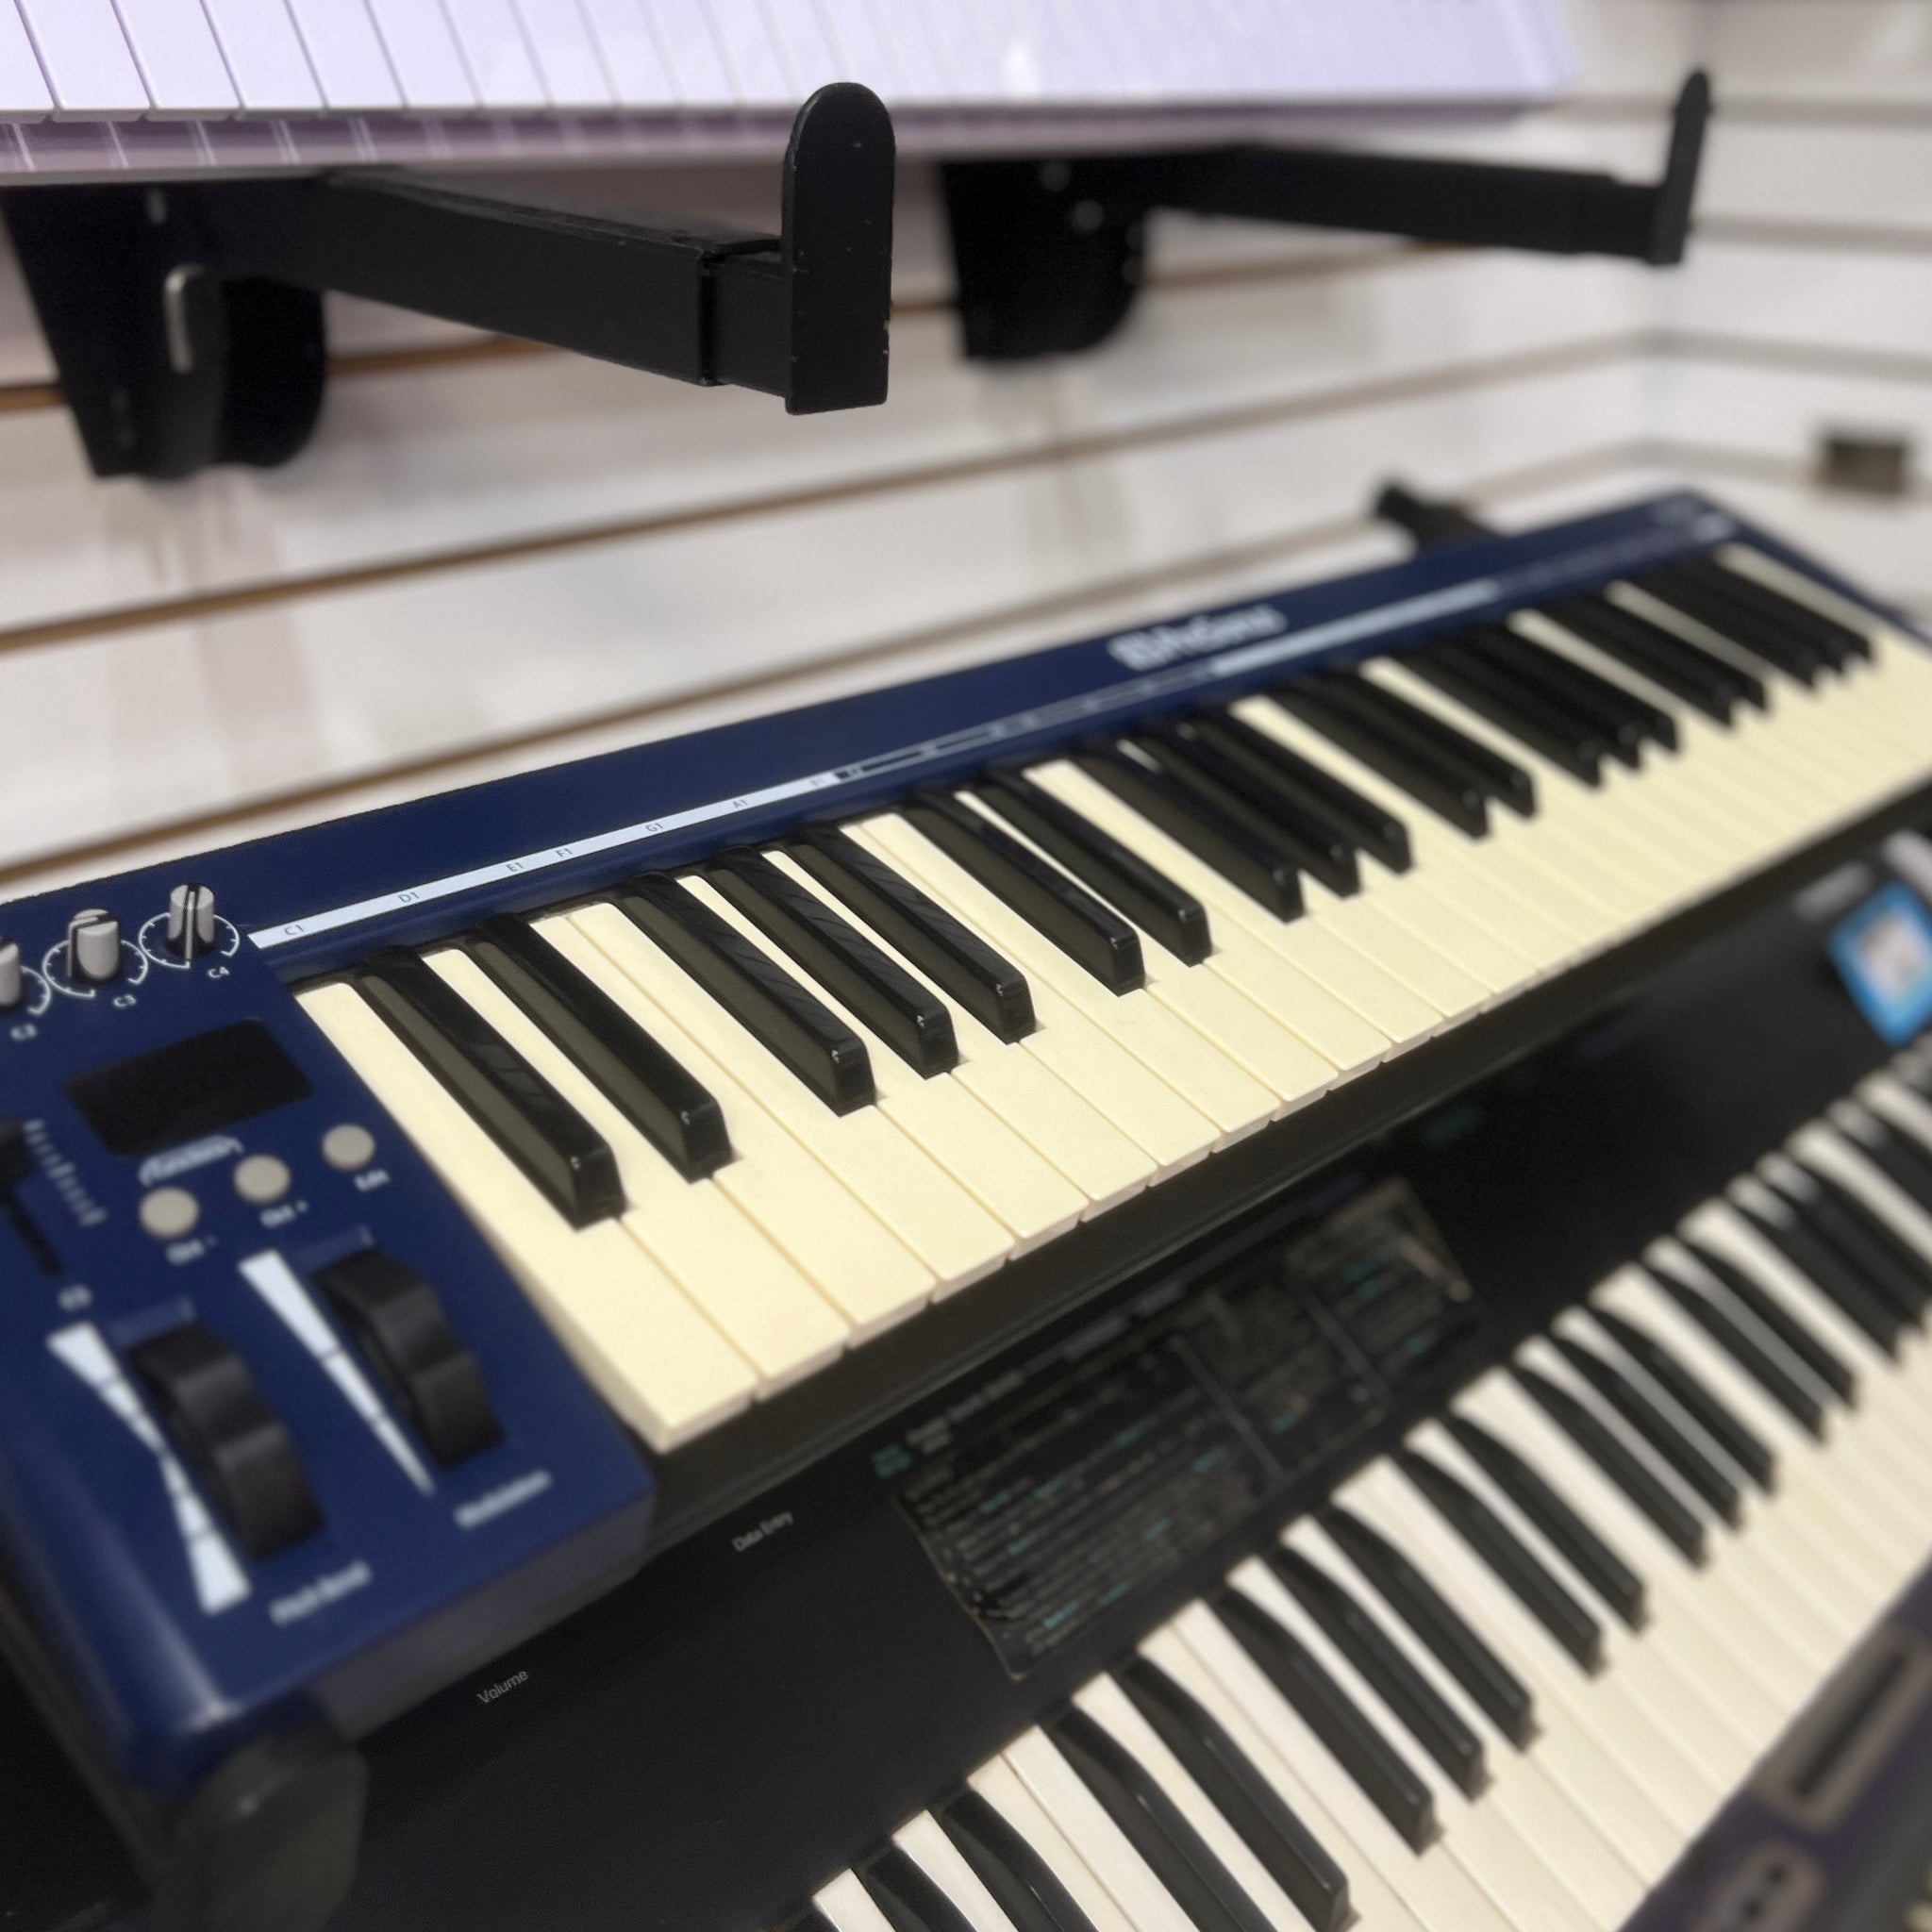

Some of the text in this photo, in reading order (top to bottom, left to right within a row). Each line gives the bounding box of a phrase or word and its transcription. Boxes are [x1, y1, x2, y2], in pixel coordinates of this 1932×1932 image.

[284, 924, 305, 937] C1
[398, 891, 420, 904] D1
[506, 861, 525, 873] E1
[556, 848, 573, 859] F1
[646, 822, 664, 833] G1
[732, 799, 749, 809] A1
[208, 966, 230, 979] C4
[112, 994, 137, 1008] C3
[476, 1671, 528, 1704] Volume
